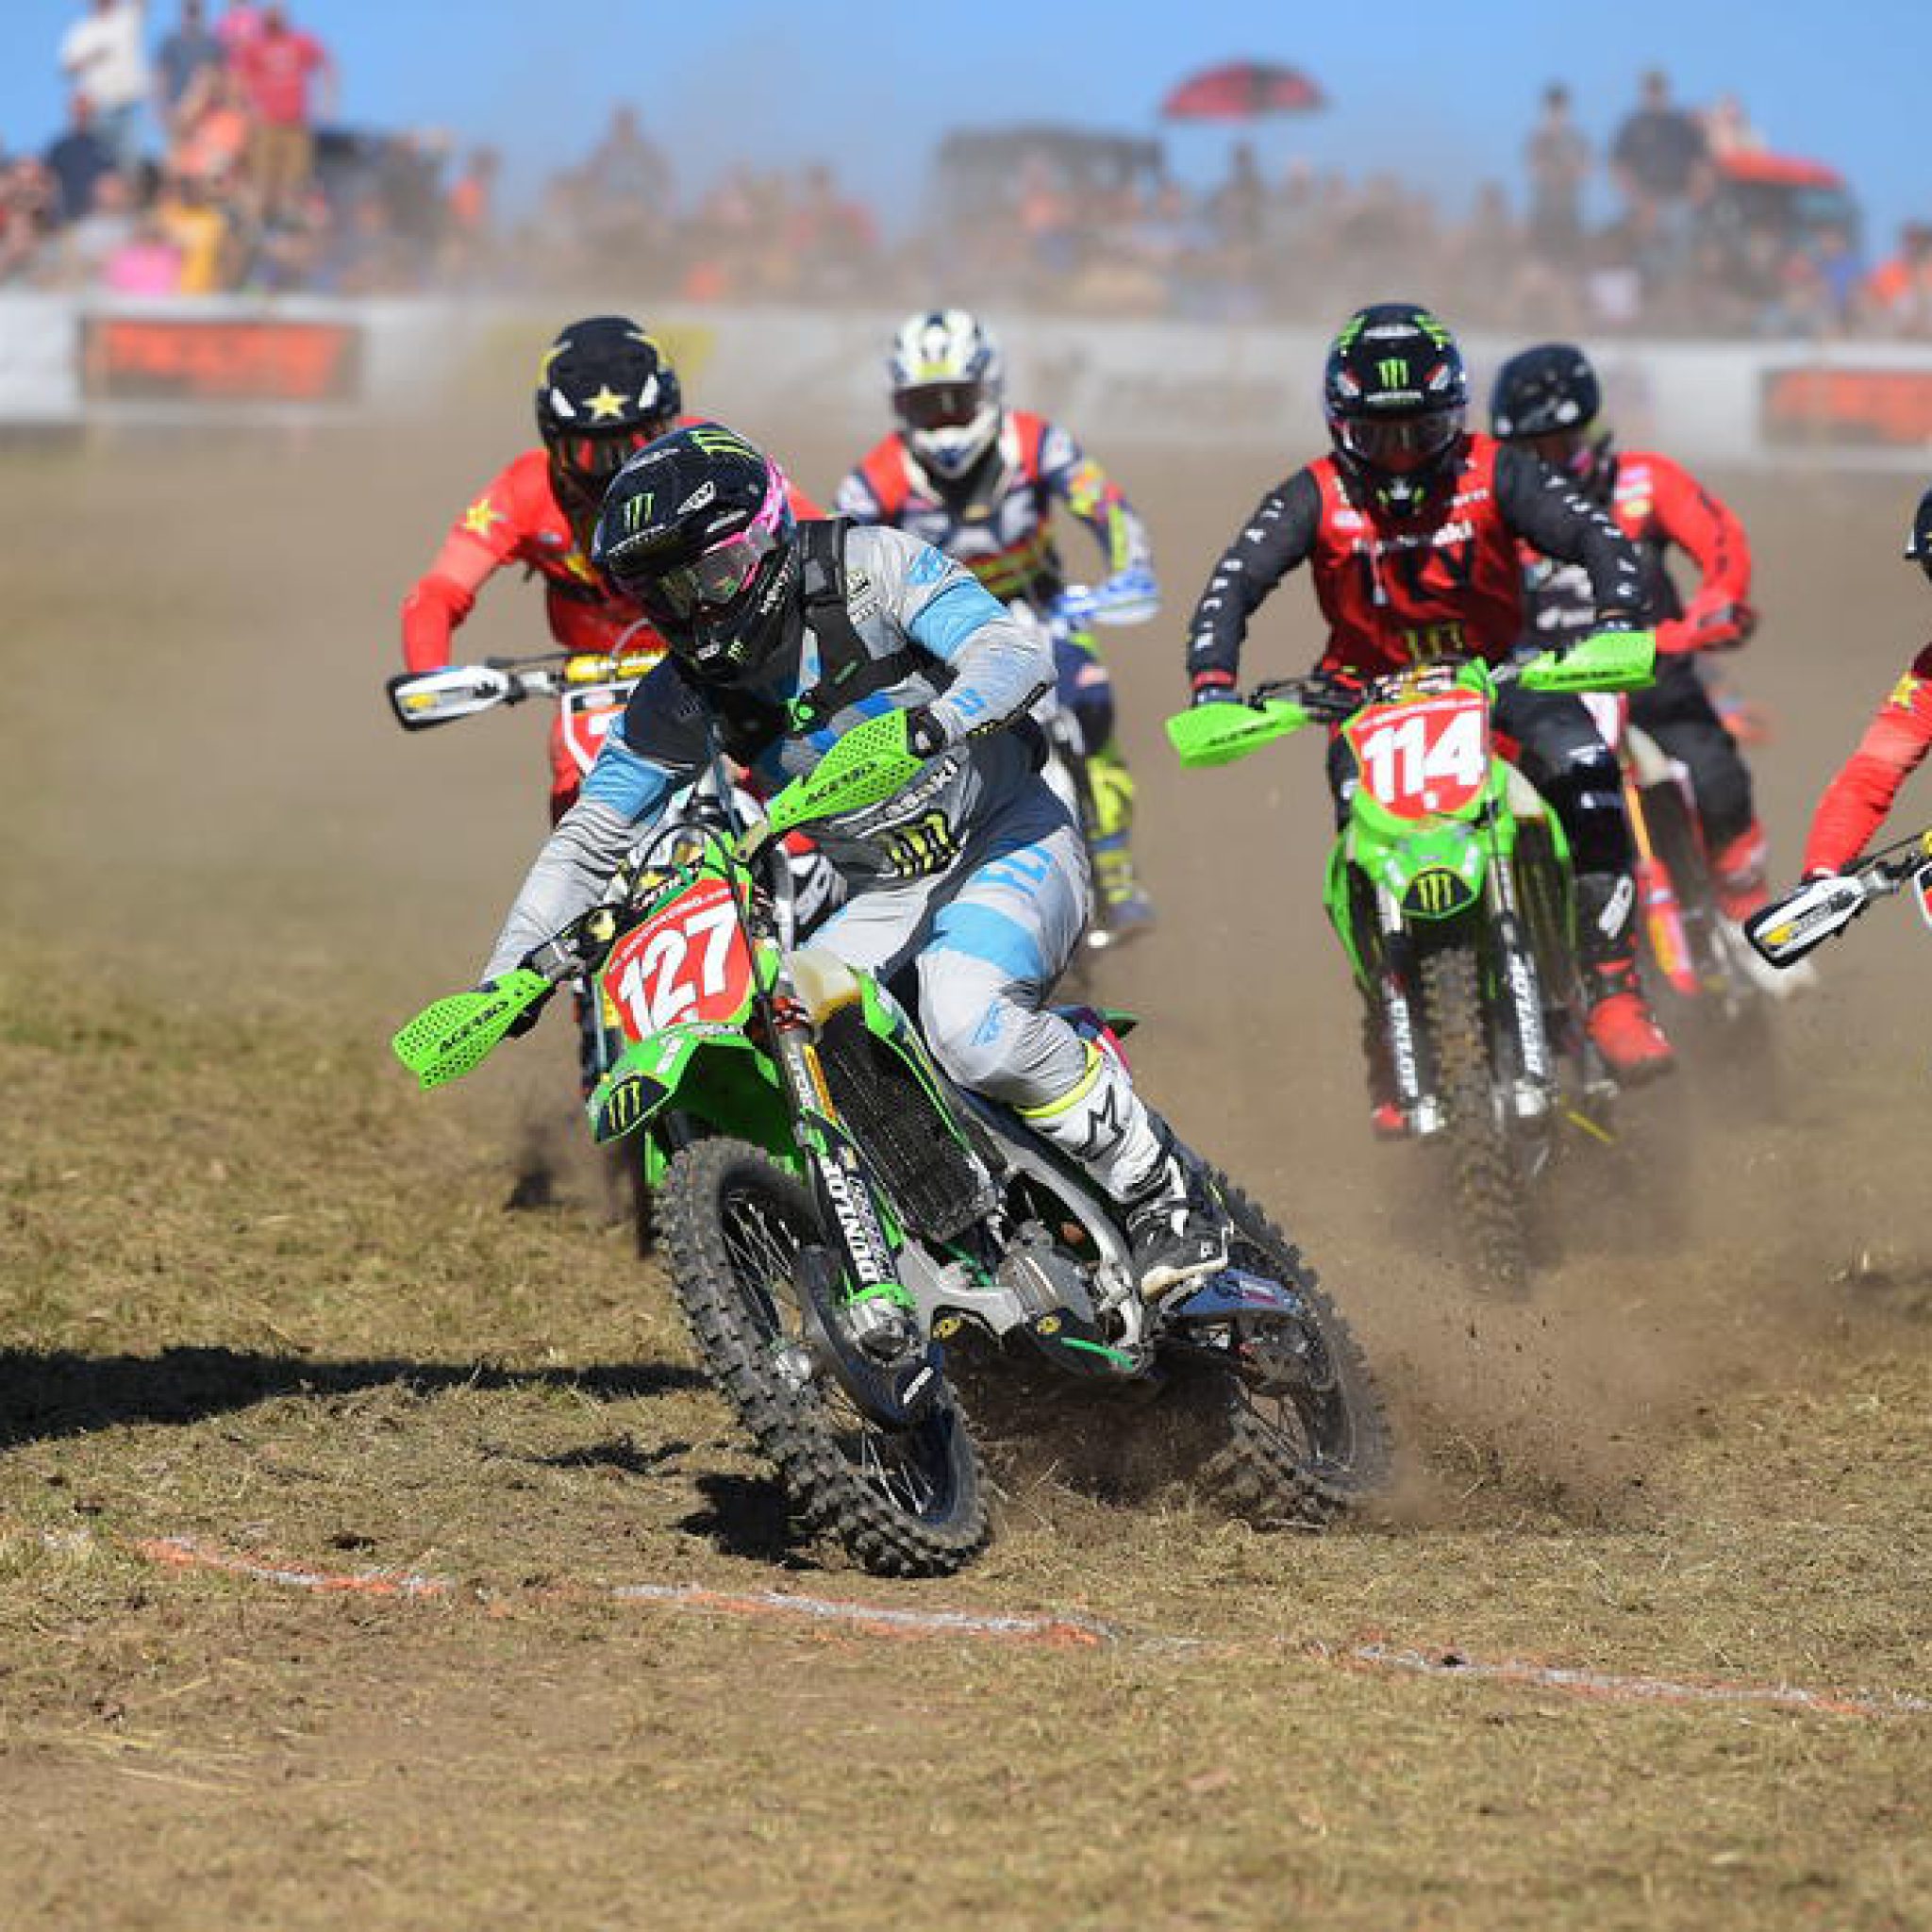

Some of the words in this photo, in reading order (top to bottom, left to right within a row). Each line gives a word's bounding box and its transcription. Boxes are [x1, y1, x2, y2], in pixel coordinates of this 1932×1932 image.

[1361, 710, 1486, 804] 114
[618, 904, 739, 1041] 127
[820, 1155, 881, 1283] DUNLOP
